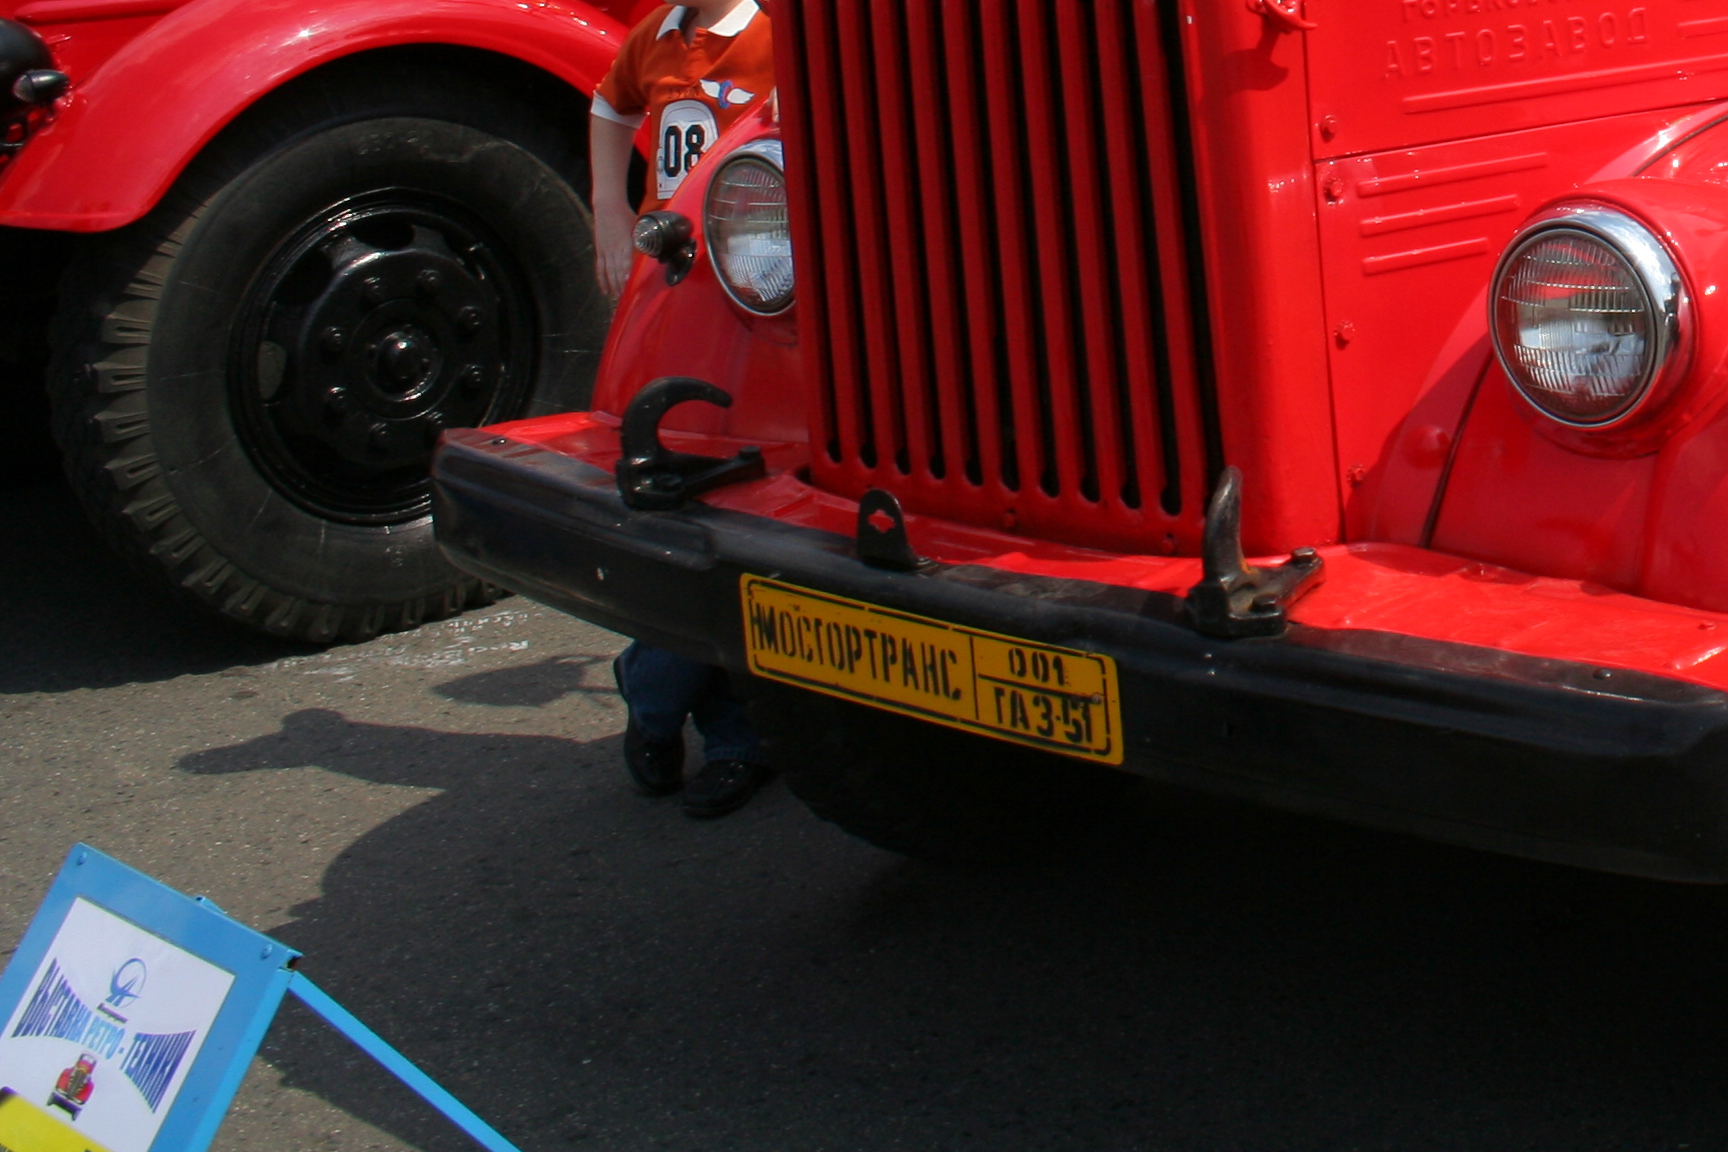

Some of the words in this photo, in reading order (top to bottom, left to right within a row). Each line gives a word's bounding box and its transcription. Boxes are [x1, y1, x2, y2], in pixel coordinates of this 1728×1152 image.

[1384, 6, 1650, 79] АВТОЗАВОД
[664, 124, 705, 178] 08
[756, 603, 962, 701] МОСГОРТРАНС
[1009, 648, 1065, 686] 001
